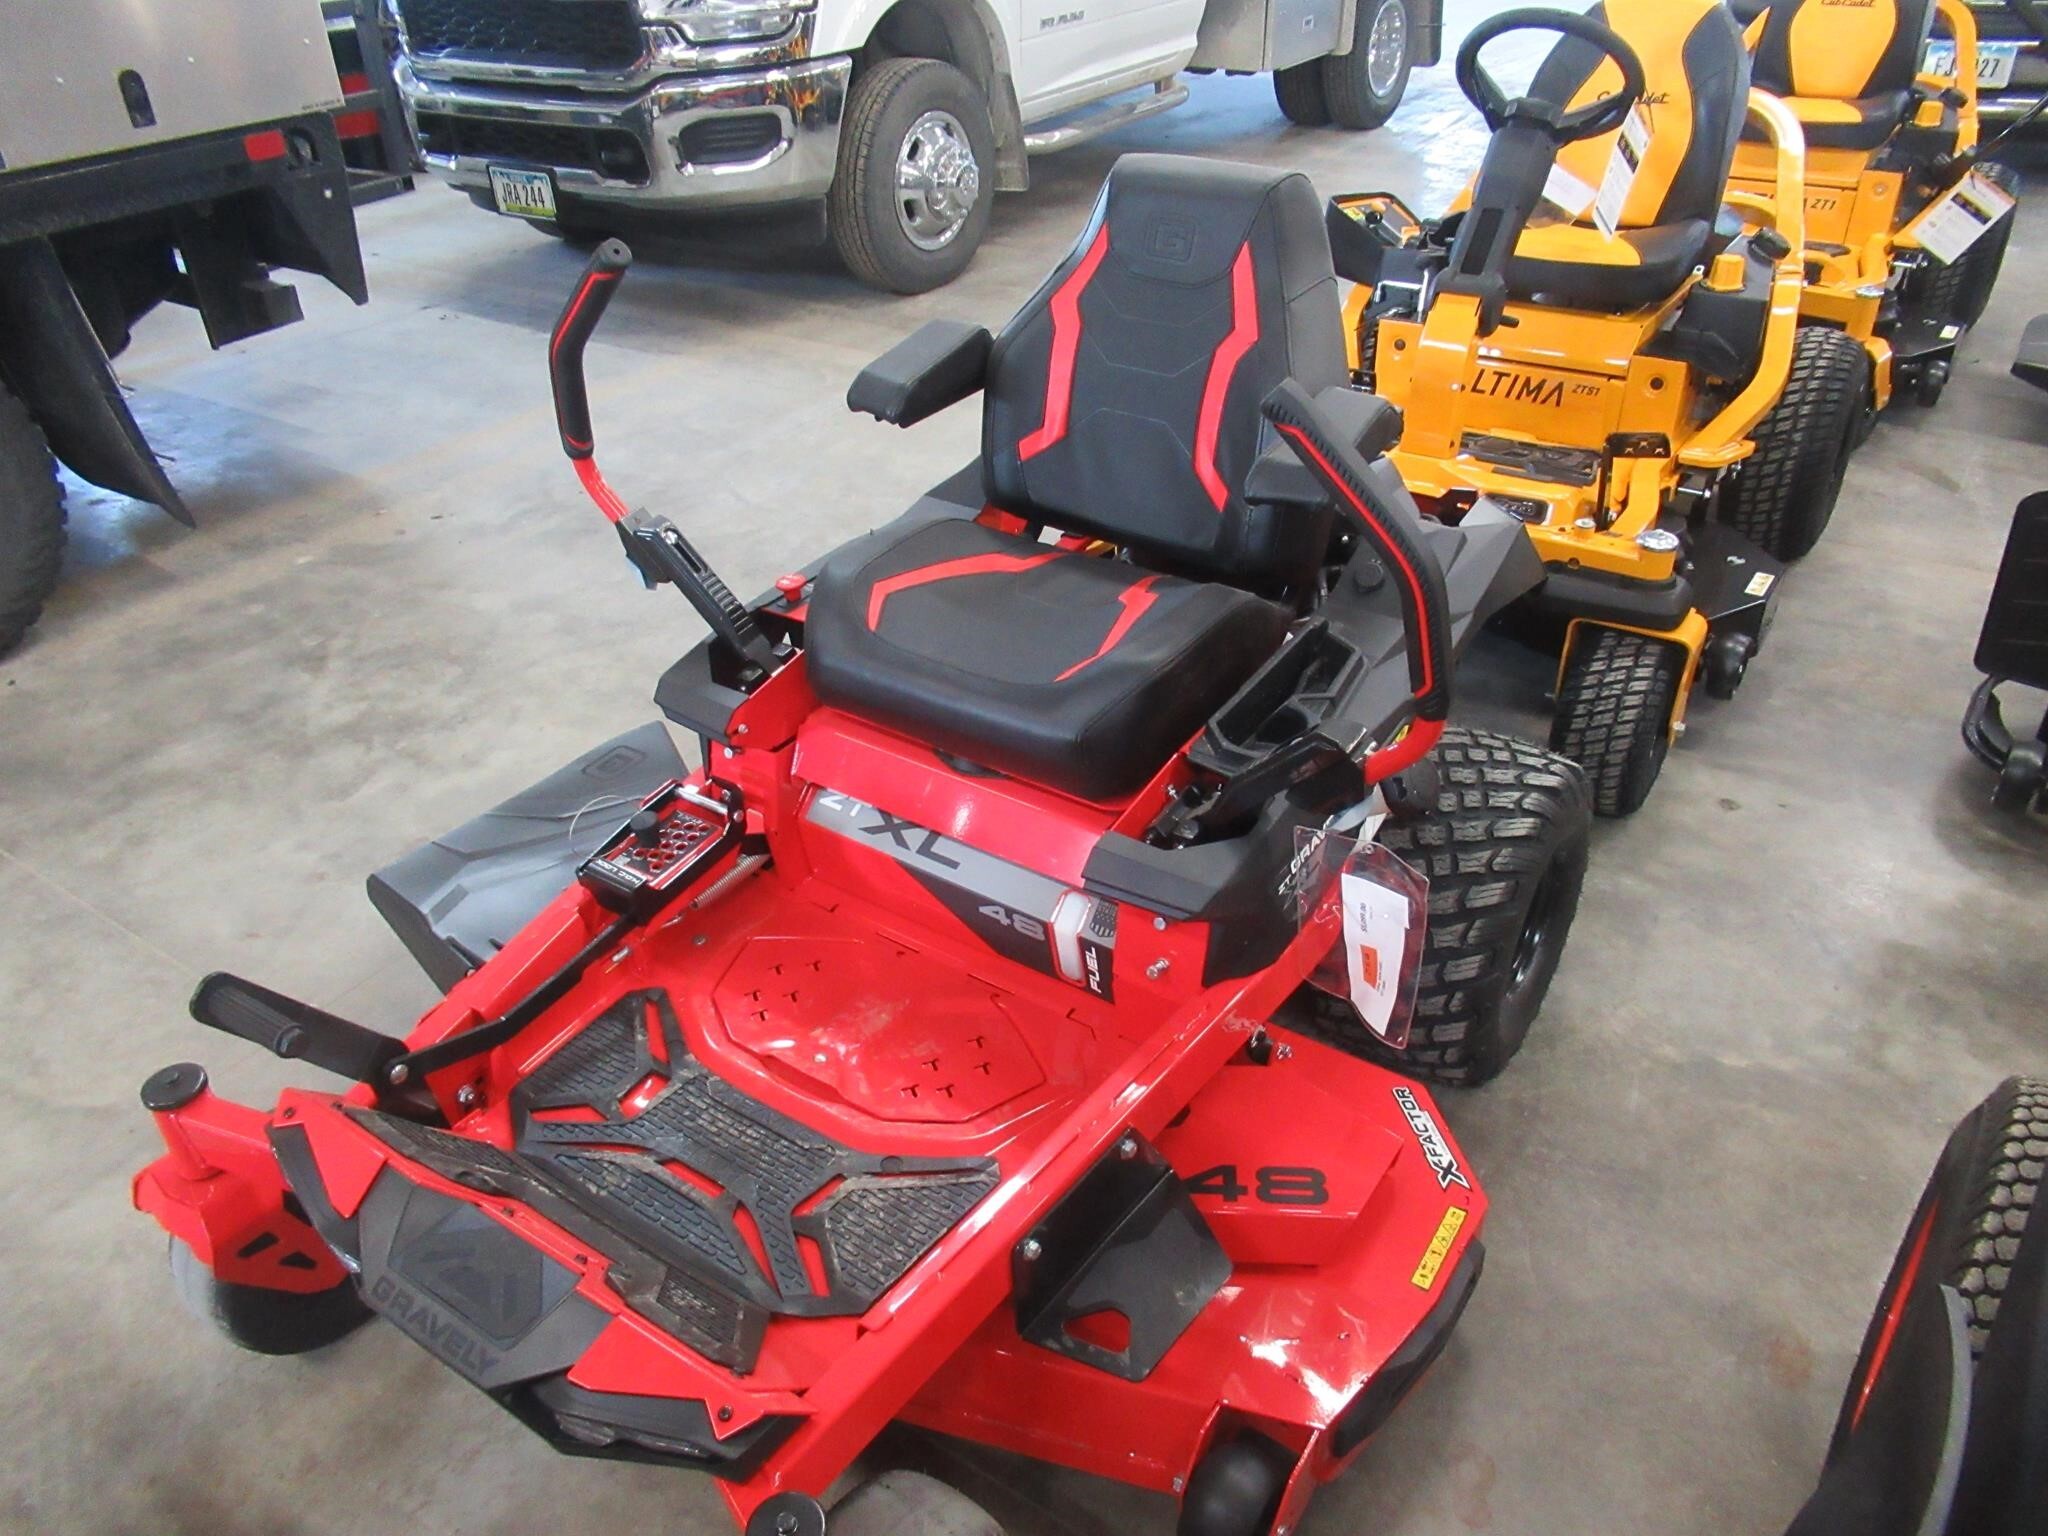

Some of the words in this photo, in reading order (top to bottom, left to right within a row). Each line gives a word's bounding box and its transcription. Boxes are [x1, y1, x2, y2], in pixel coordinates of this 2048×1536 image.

[1933, 56, 1956, 76] FJ
[1810, 198, 1827, 211] ZT1
[1461, 368, 1564, 407] LTIMA
[858, 807, 961, 870] XL
[978, 904, 1046, 942] 48
[1085, 946, 1102, 994] FUEL
[1395, 1087, 1465, 1185] X-FACTOR
[1188, 1164, 1329, 1205] 48
[371, 1275, 501, 1378] GRAVELY
